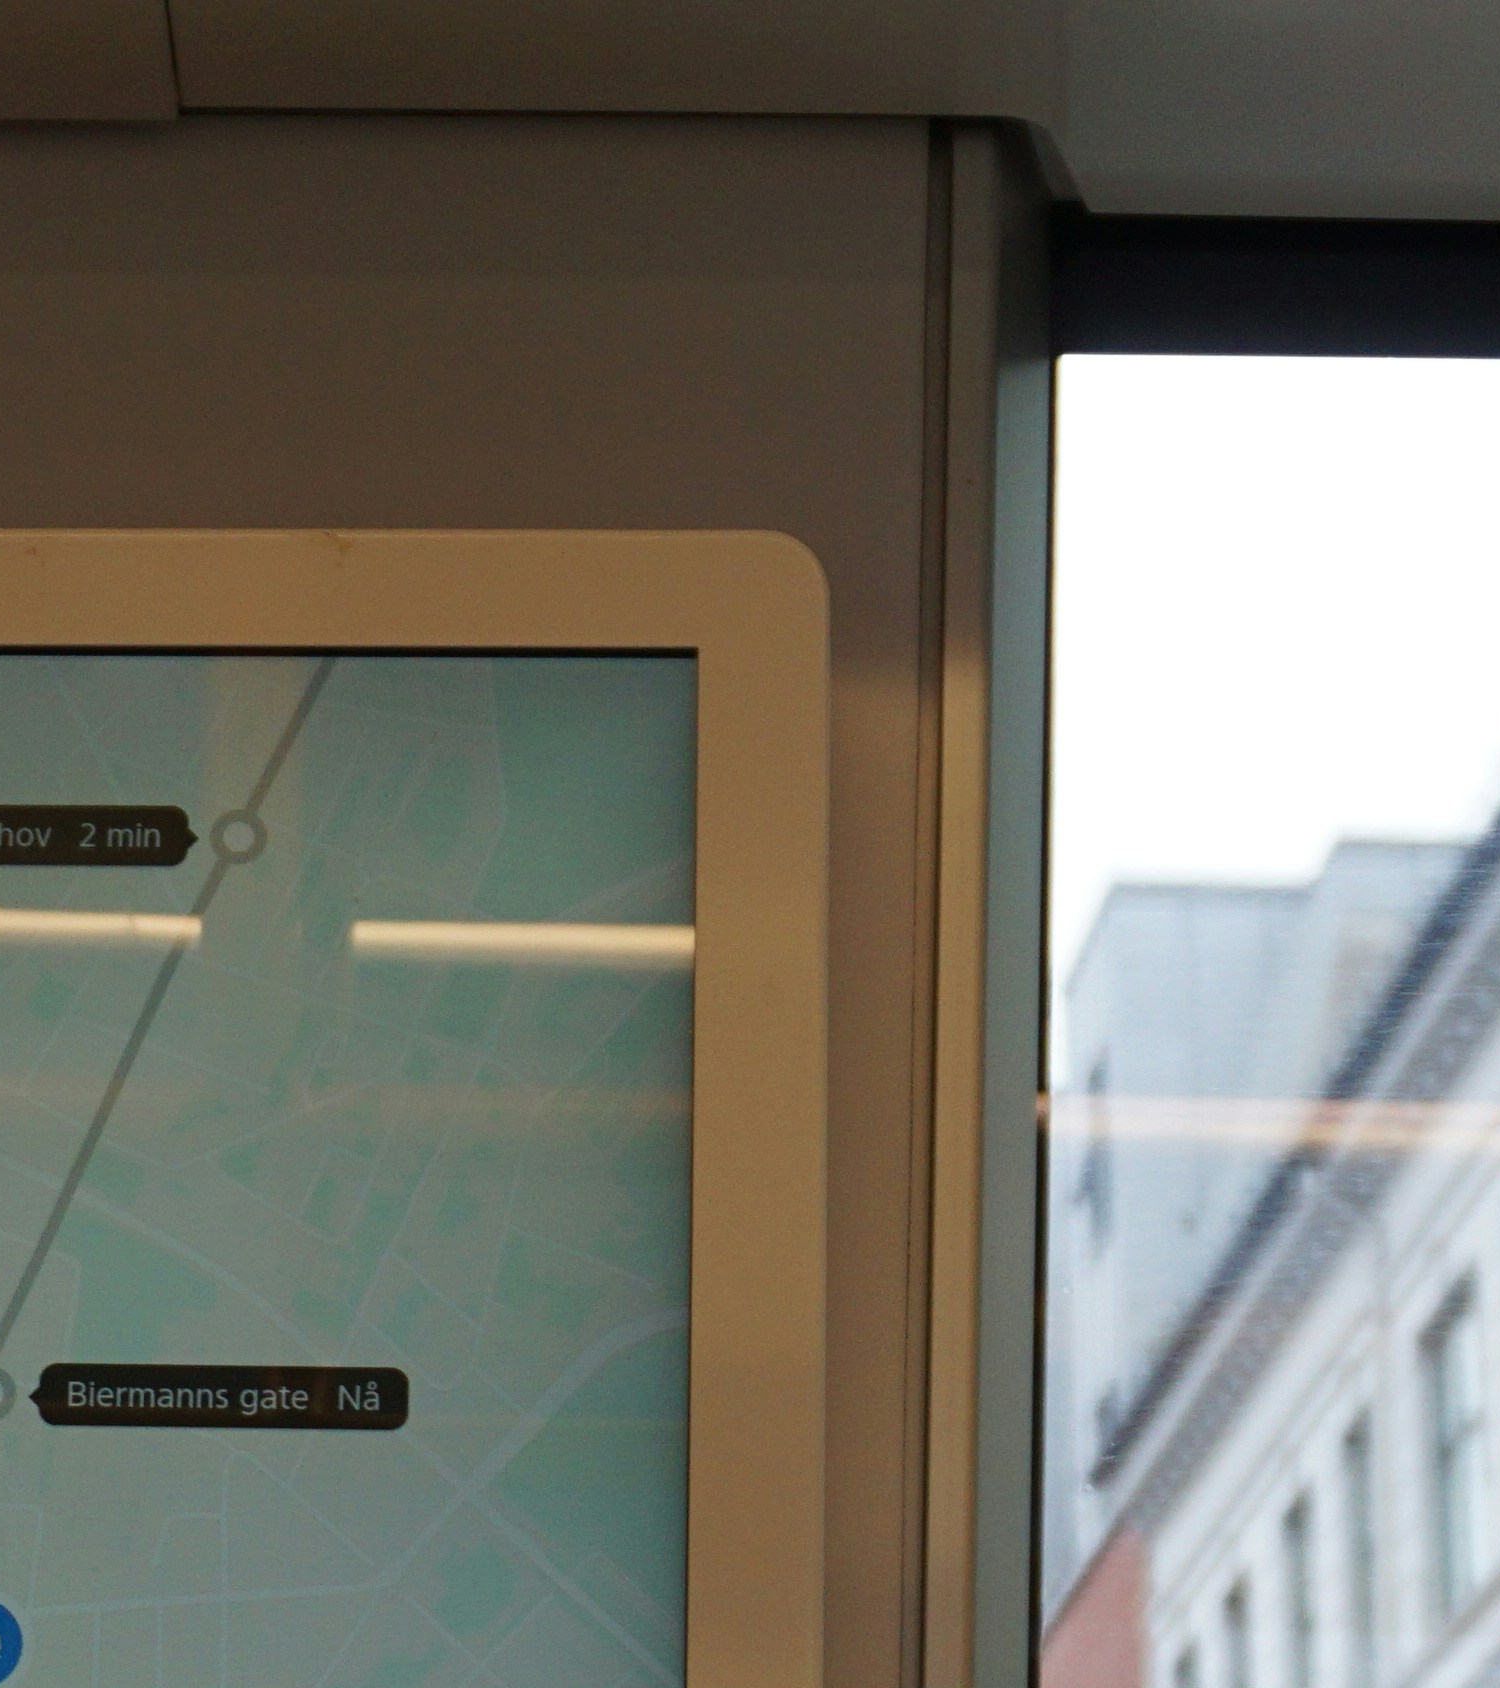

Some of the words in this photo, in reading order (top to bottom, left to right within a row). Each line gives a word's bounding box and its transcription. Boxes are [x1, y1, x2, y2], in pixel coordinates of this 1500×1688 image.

[79, 822, 96, 848] 2
[106, 822, 161, 848] min
[67, 1380, 229, 1409] Biermanns
[239, 1386, 309, 1416] gate
[338, 1380, 380, 1411] Nå
